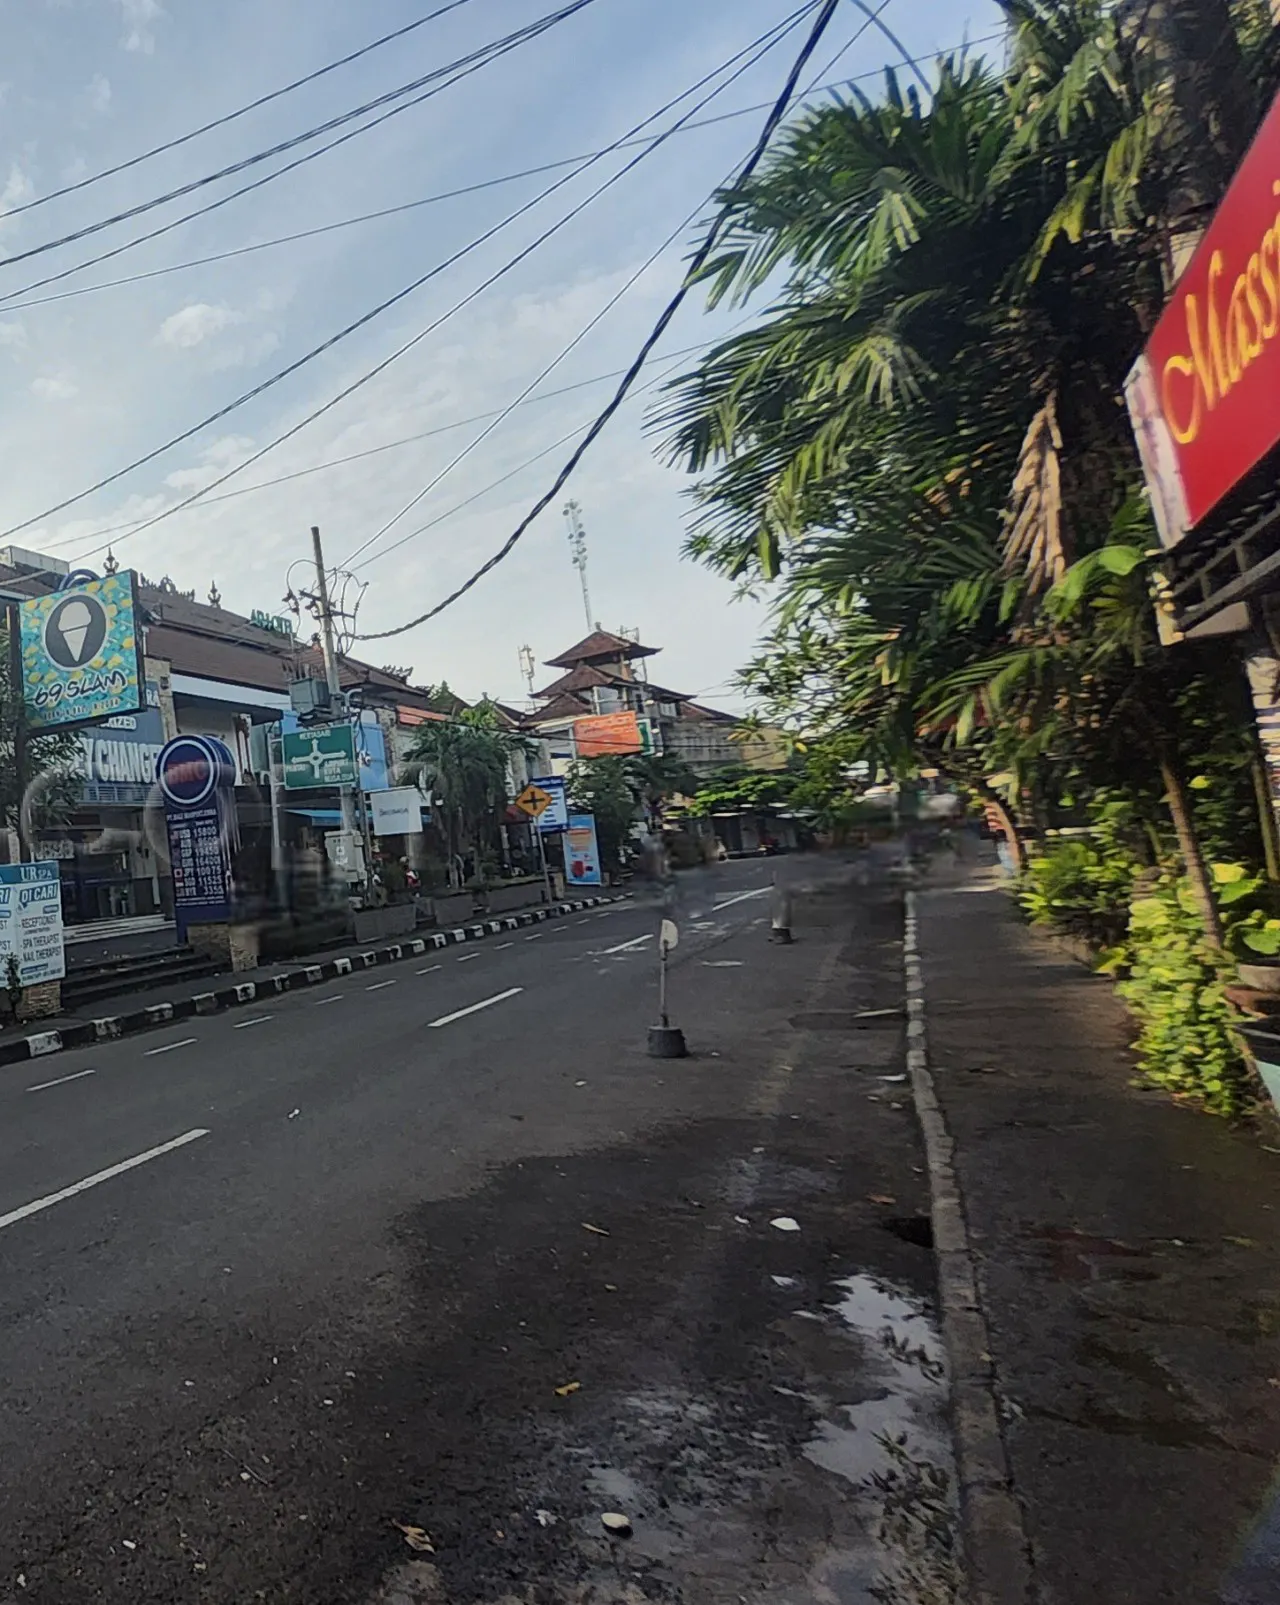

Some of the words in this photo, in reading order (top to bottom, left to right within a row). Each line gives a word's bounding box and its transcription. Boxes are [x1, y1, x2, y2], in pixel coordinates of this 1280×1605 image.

[34, 683, 63, 707] 69
[65, 669, 128, 699] SLAM
[20, 866, 37, 881] UR
[37, 869, 52, 880] SPA
[21, 890, 32, 903] DI
[34, 884, 57, 900] CARI
